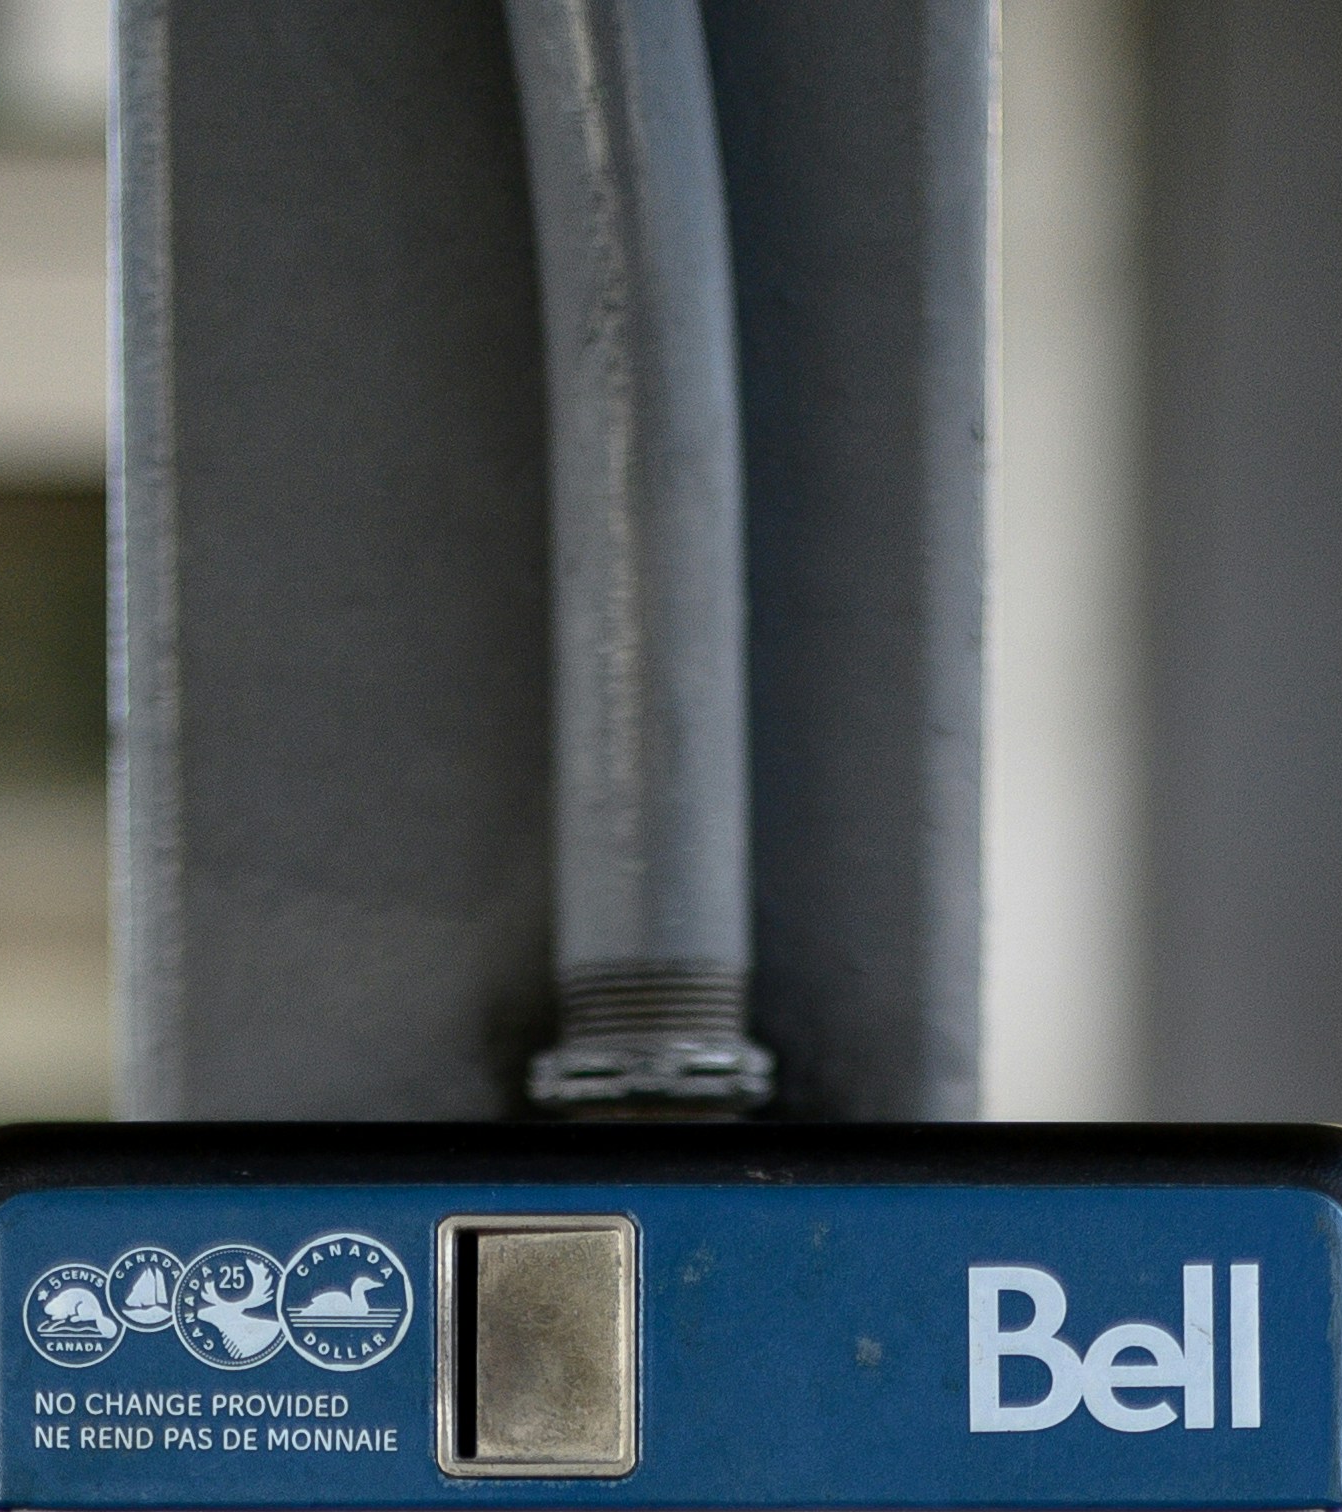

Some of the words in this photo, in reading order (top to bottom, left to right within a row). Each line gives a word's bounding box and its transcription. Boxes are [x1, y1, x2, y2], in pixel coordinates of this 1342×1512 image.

[114, 1252, 181, 1281] CANADA
[296, 1243, 394, 1281] CANADA
[47, 1275, 62, 1291] 5
[62, 1270, 106, 1289] CENTS
[218, 1266, 245, 1289] 25
[185, 1265, 214, 1352] CANADA
[45, 1340, 104, 1353] CANADA
[302, 1332, 388, 1360] DOLLAR
[968, 1263, 1260, 1433] Bell
[35, 1391, 76, 1415] NO
[85, 1392, 202, 1416] CHANGE
[212, 1393, 349, 1418] PROVIDED
[35, 1425, 71, 1450] NE
[80, 1426, 154, 1450] REND
[164, 1427, 213, 1451] PAS
[223, 1427, 258, 1451] DE
[267, 1427, 398, 1452] MONNAIE
